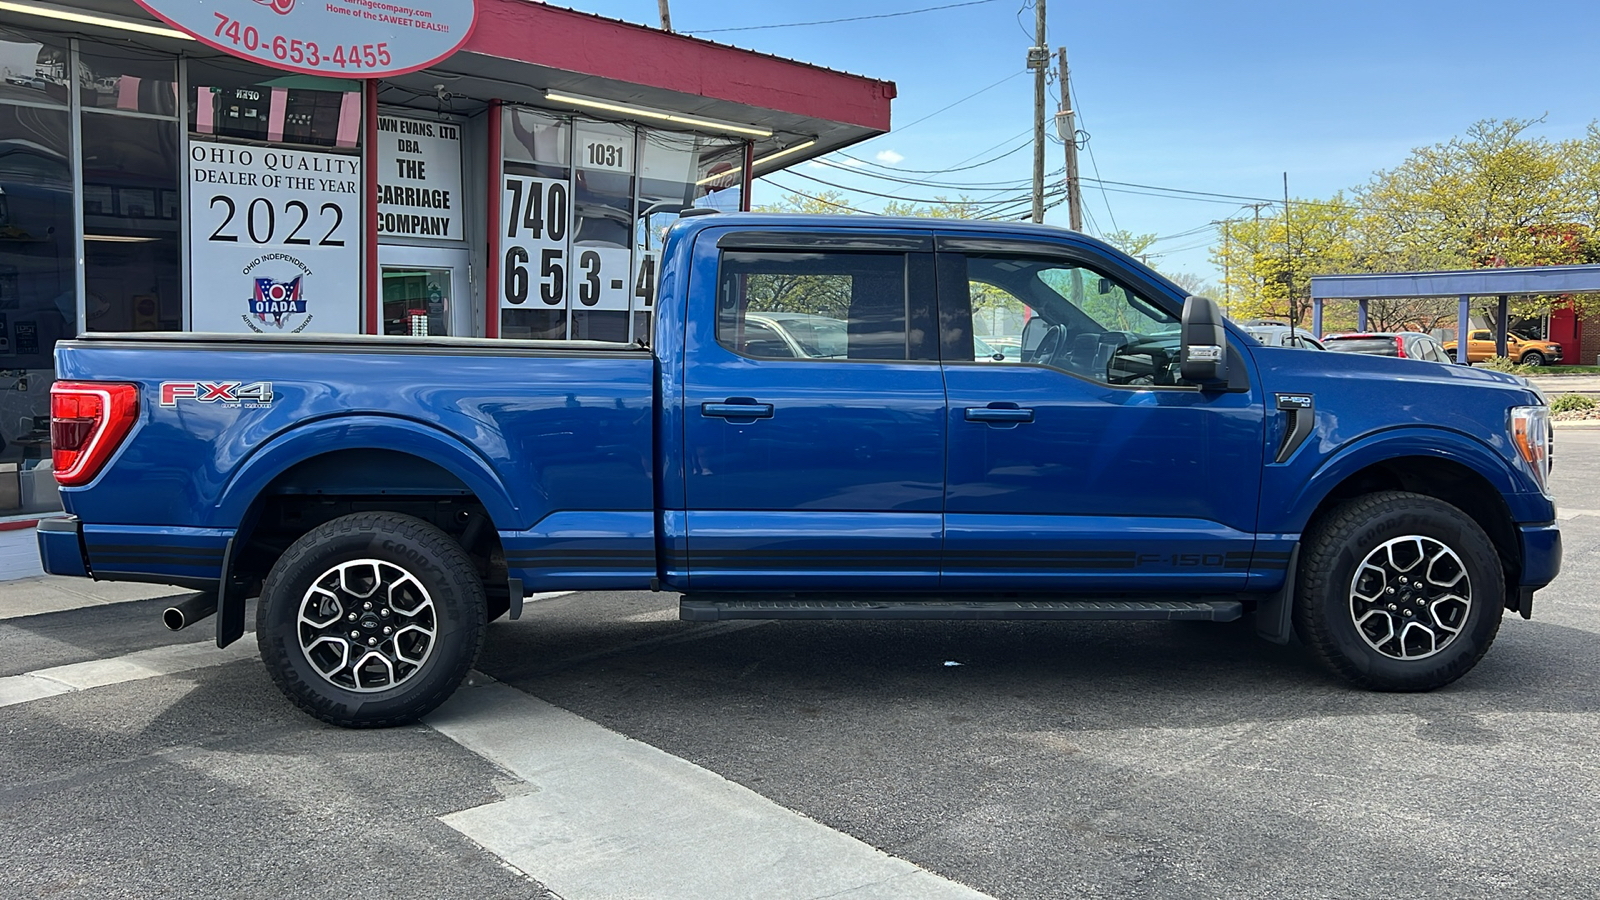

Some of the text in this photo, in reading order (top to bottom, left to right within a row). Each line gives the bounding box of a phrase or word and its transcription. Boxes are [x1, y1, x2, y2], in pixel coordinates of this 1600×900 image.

[326, 3, 351, 15] Home
[363, 11, 377, 20] the
[378, 14, 413, 27] SAWEET
[415, 20, 449, 33] DEALS!!!
[213, 11, 392, 69] 740-653-4455
[400, 120, 436, 138] EVANS.
[439, 125, 459, 141] LTD.
[397, 138, 422, 154] DBA.
[588, 143, 623, 168] 1031
[192, 146, 359, 175] OHIO QUALITY
[396, 158, 426, 180] THE
[194, 168, 357, 194] DEALER OF THE YEAR
[377, 184, 450, 209] CARRIAGE
[208, 195, 345, 247] 2022
[506, 179, 567, 241] 740
[377, 212, 450, 236] COMPANY
[242, 253, 313, 276] OHIO INDEPENDENT
[256, 301, 298, 313] OIADA
[159, 380, 274, 408] FX4
[1136, 553, 1225, 567] F-150
